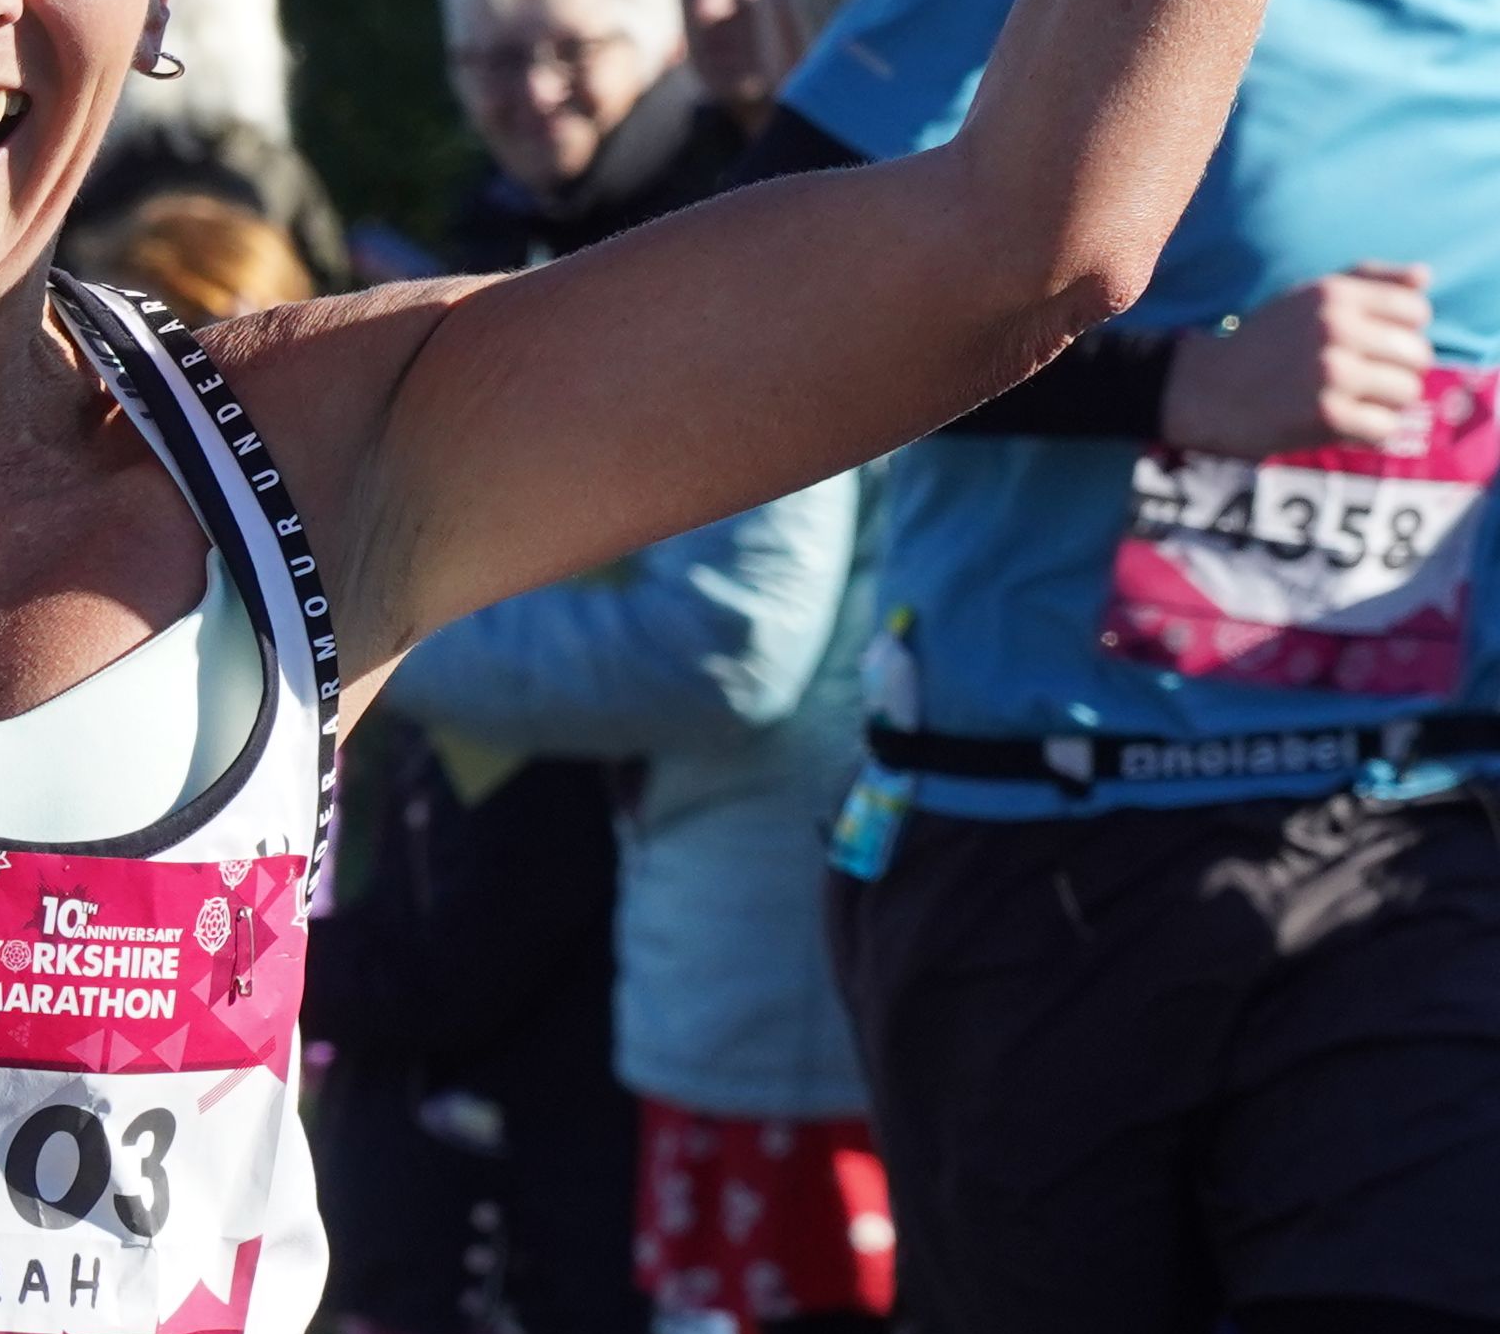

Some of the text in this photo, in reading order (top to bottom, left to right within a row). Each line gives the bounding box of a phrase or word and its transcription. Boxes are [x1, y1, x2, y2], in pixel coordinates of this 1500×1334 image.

[182, 349, 280, 492] UNDER
[277, 514, 339, 735] ARMOUR
[73, 924, 184, 943] ANNIVERSARY
